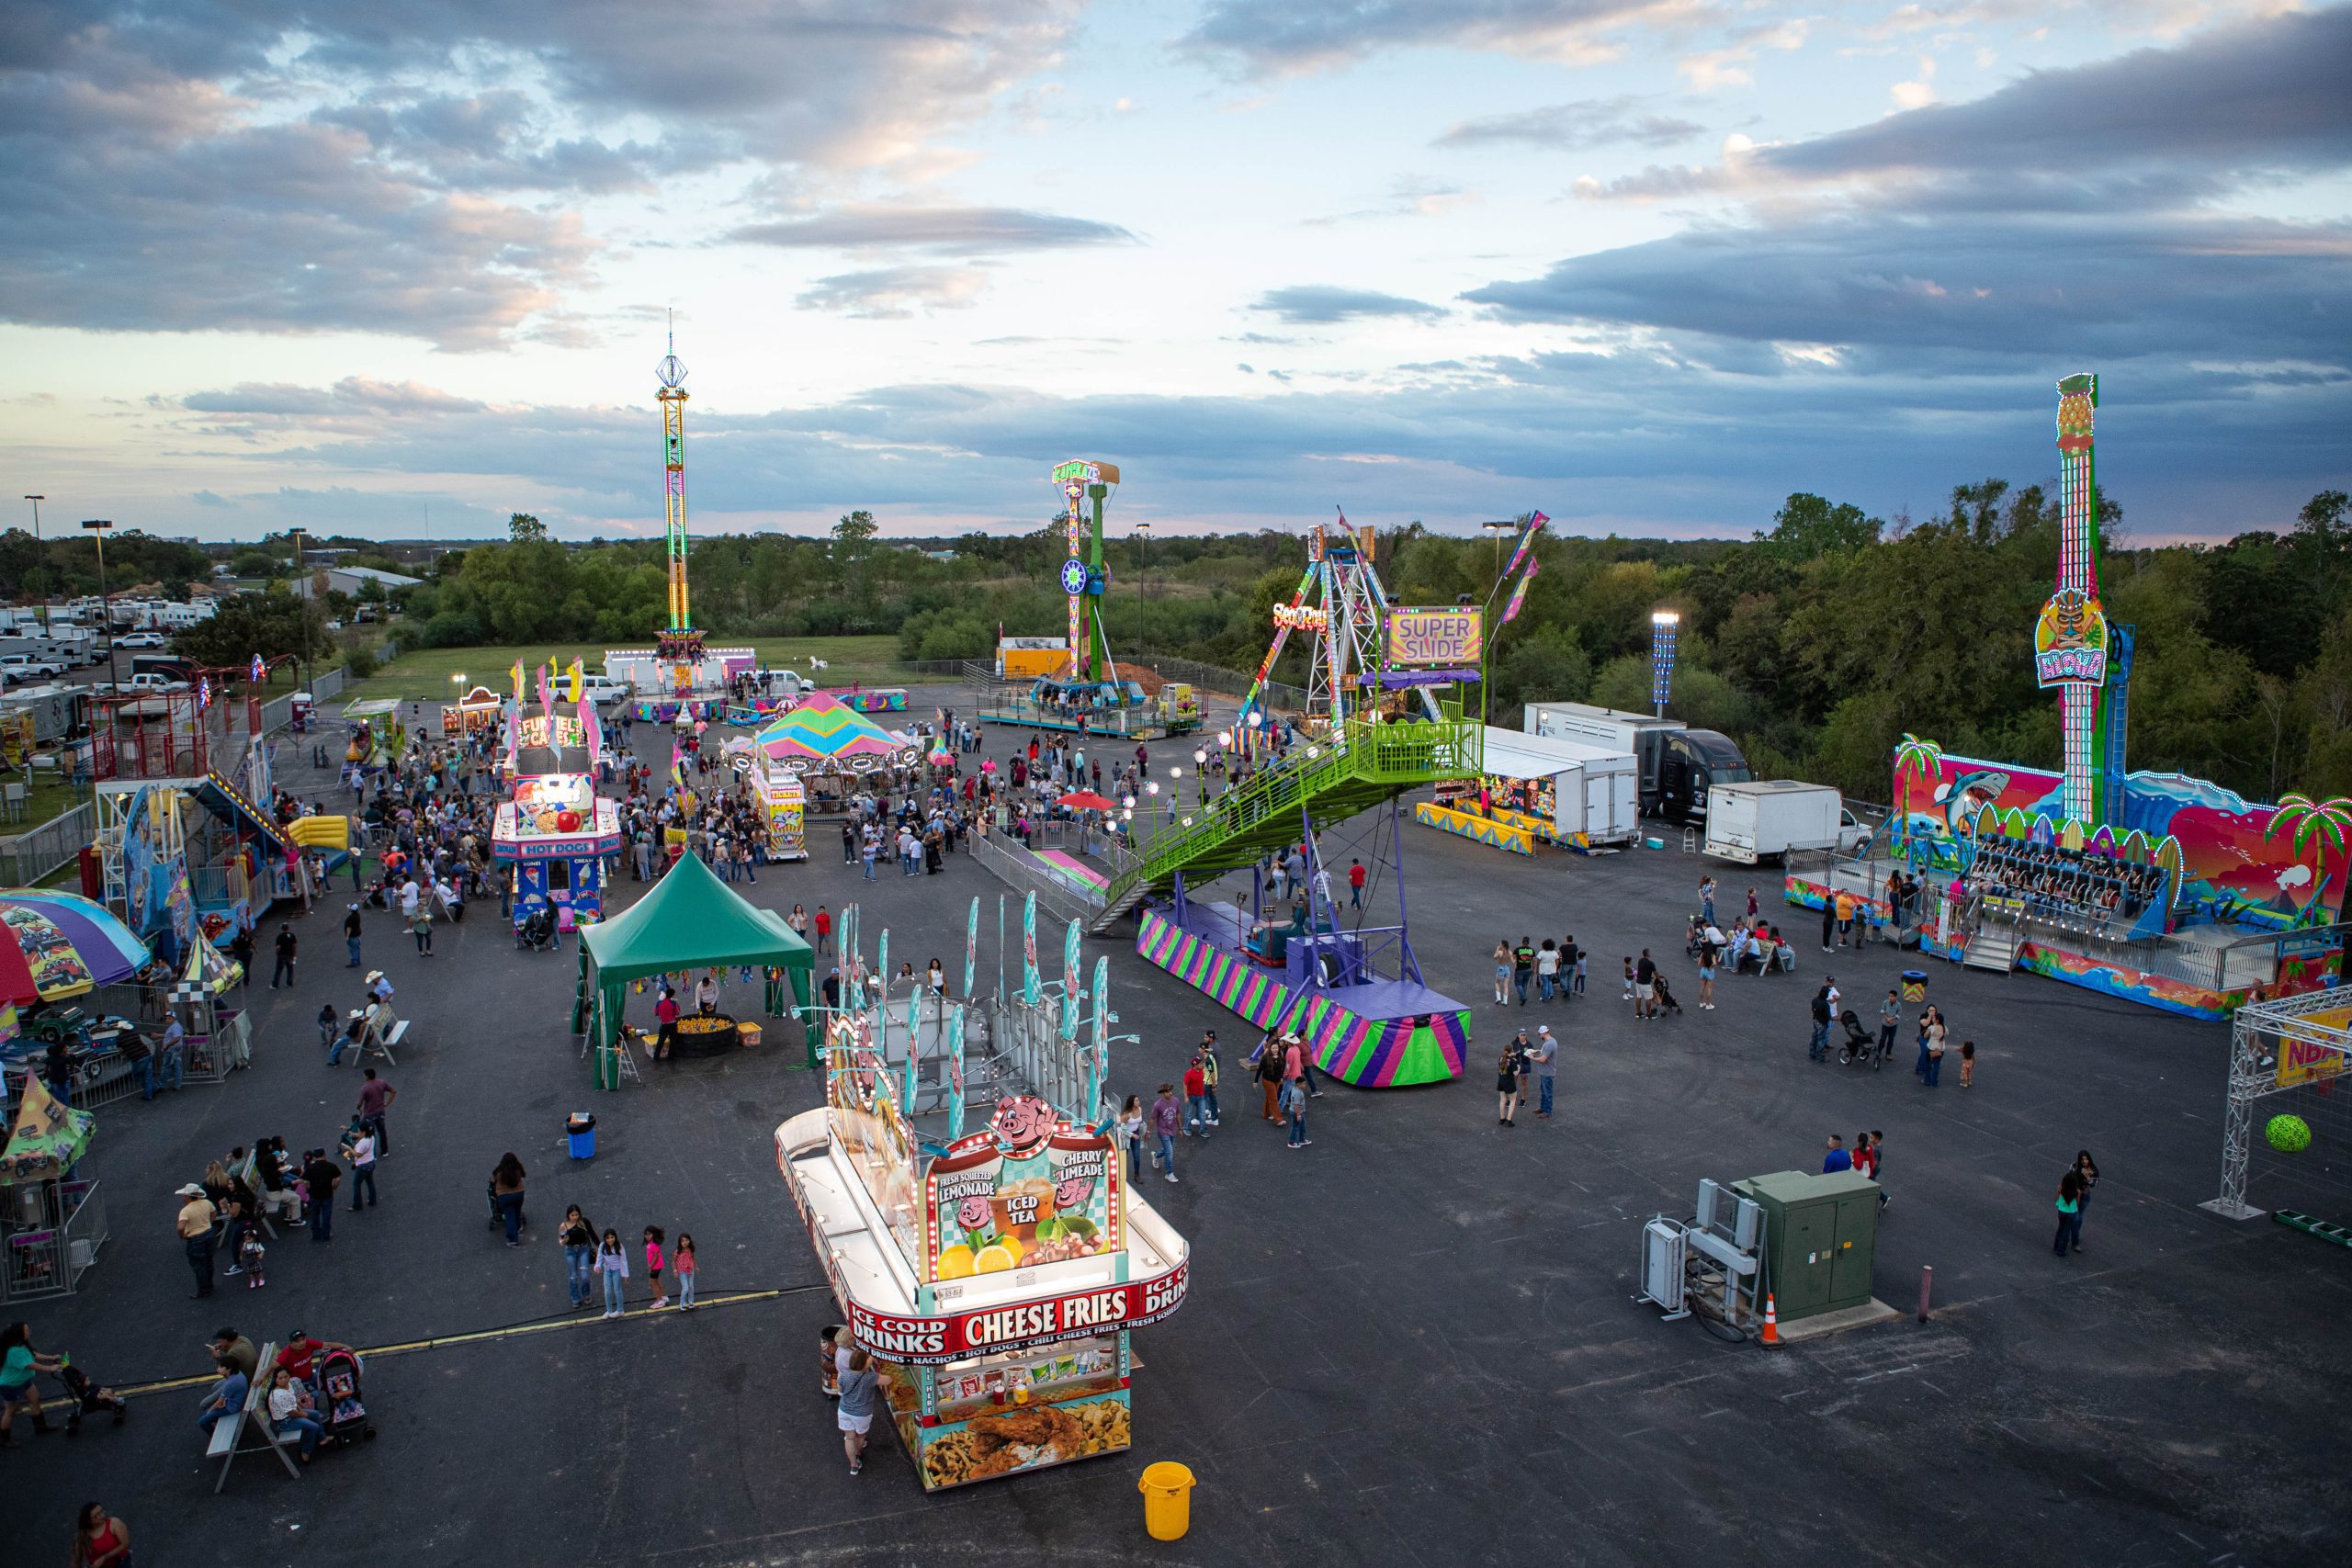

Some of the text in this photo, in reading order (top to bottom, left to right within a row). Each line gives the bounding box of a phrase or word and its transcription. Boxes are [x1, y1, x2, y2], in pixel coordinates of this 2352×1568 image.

[1399, 617, 1470, 637] SUPER
[1406, 639, 1464, 659] SLIDE
[2040, 651, 2104, 679] ALOHA
[522, 716, 576, 735] FUNEL
[530, 730, 569, 746] CAES
[772, 790, 801, 798] TICKETS
[526, 842, 588, 854] HOT DOGS
[1061, 1150, 1102, 1167] CHERRY
[939, 1171, 993, 1188] FRESH SQUEEZED
[1060, 1164, 1103, 1182] LIMEADE
[939, 1182, 996, 1202] LEMONADE
[1007, 1196, 1039, 1213] ICED
[1010, 1212, 1037, 1224] TEA
[1146, 1259, 1189, 1295] ICE CO
[1146, 1276, 1189, 1314] DRIN
[852, 1305, 947, 1333] ICE COLD
[965, 1290, 1127, 1346] CHEESE FRIES
[853, 1318, 944, 1352] DRINKS
[871, 1348, 904, 1363] DRINKS
[913, 1354, 956, 1364] NACHOS
[966, 1348, 988, 1358] HOT
[990, 1341, 1020, 1353] DOGS
[1028, 1337, 1055, 1347] CHILI
[1057, 1328, 1092, 1341] CHEESE
[1094, 1324, 1120, 1334] FRIES
[1126, 1317, 1155, 1328] FRESH
